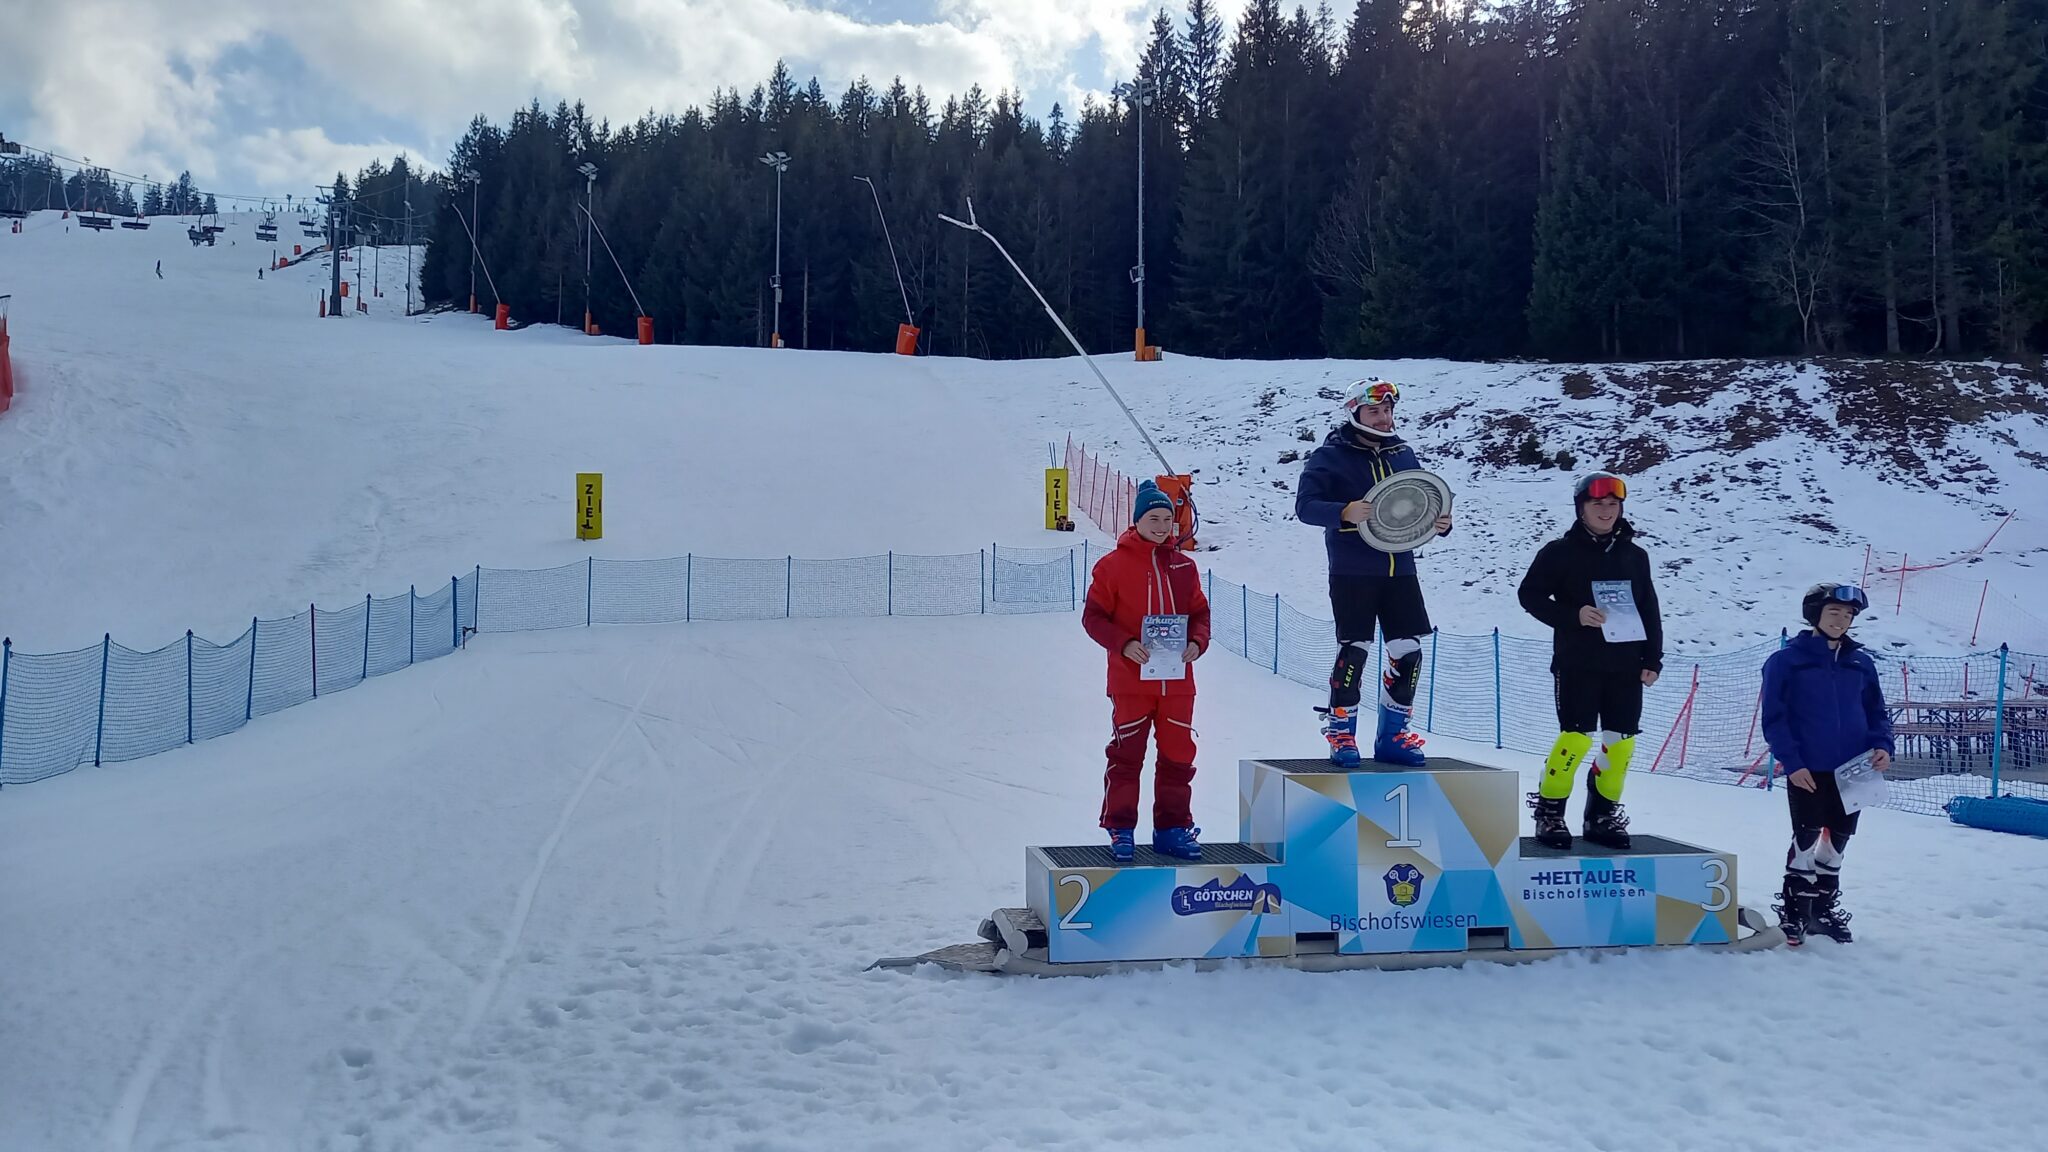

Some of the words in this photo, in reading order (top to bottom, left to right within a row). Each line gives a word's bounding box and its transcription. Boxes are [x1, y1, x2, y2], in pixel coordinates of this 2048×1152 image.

[585, 483, 594, 529] ZIEL
[1053, 478, 1062, 521] ZIEL
[1344, 664, 1355, 688] LEKI
[1563, 754, 1576, 772] LEKI
[1385, 783, 1422, 848] 1
[1530, 870, 1636, 885] HEITAUER
[1701, 858, 1731, 912] 3
[1058, 873, 1093, 931] 2
[1194, 889, 1253, 901] GÖTSCHEN
[1523, 887, 1645, 900] Bischofswiesen
[1330, 911, 1478, 931] Bischofswiesen
